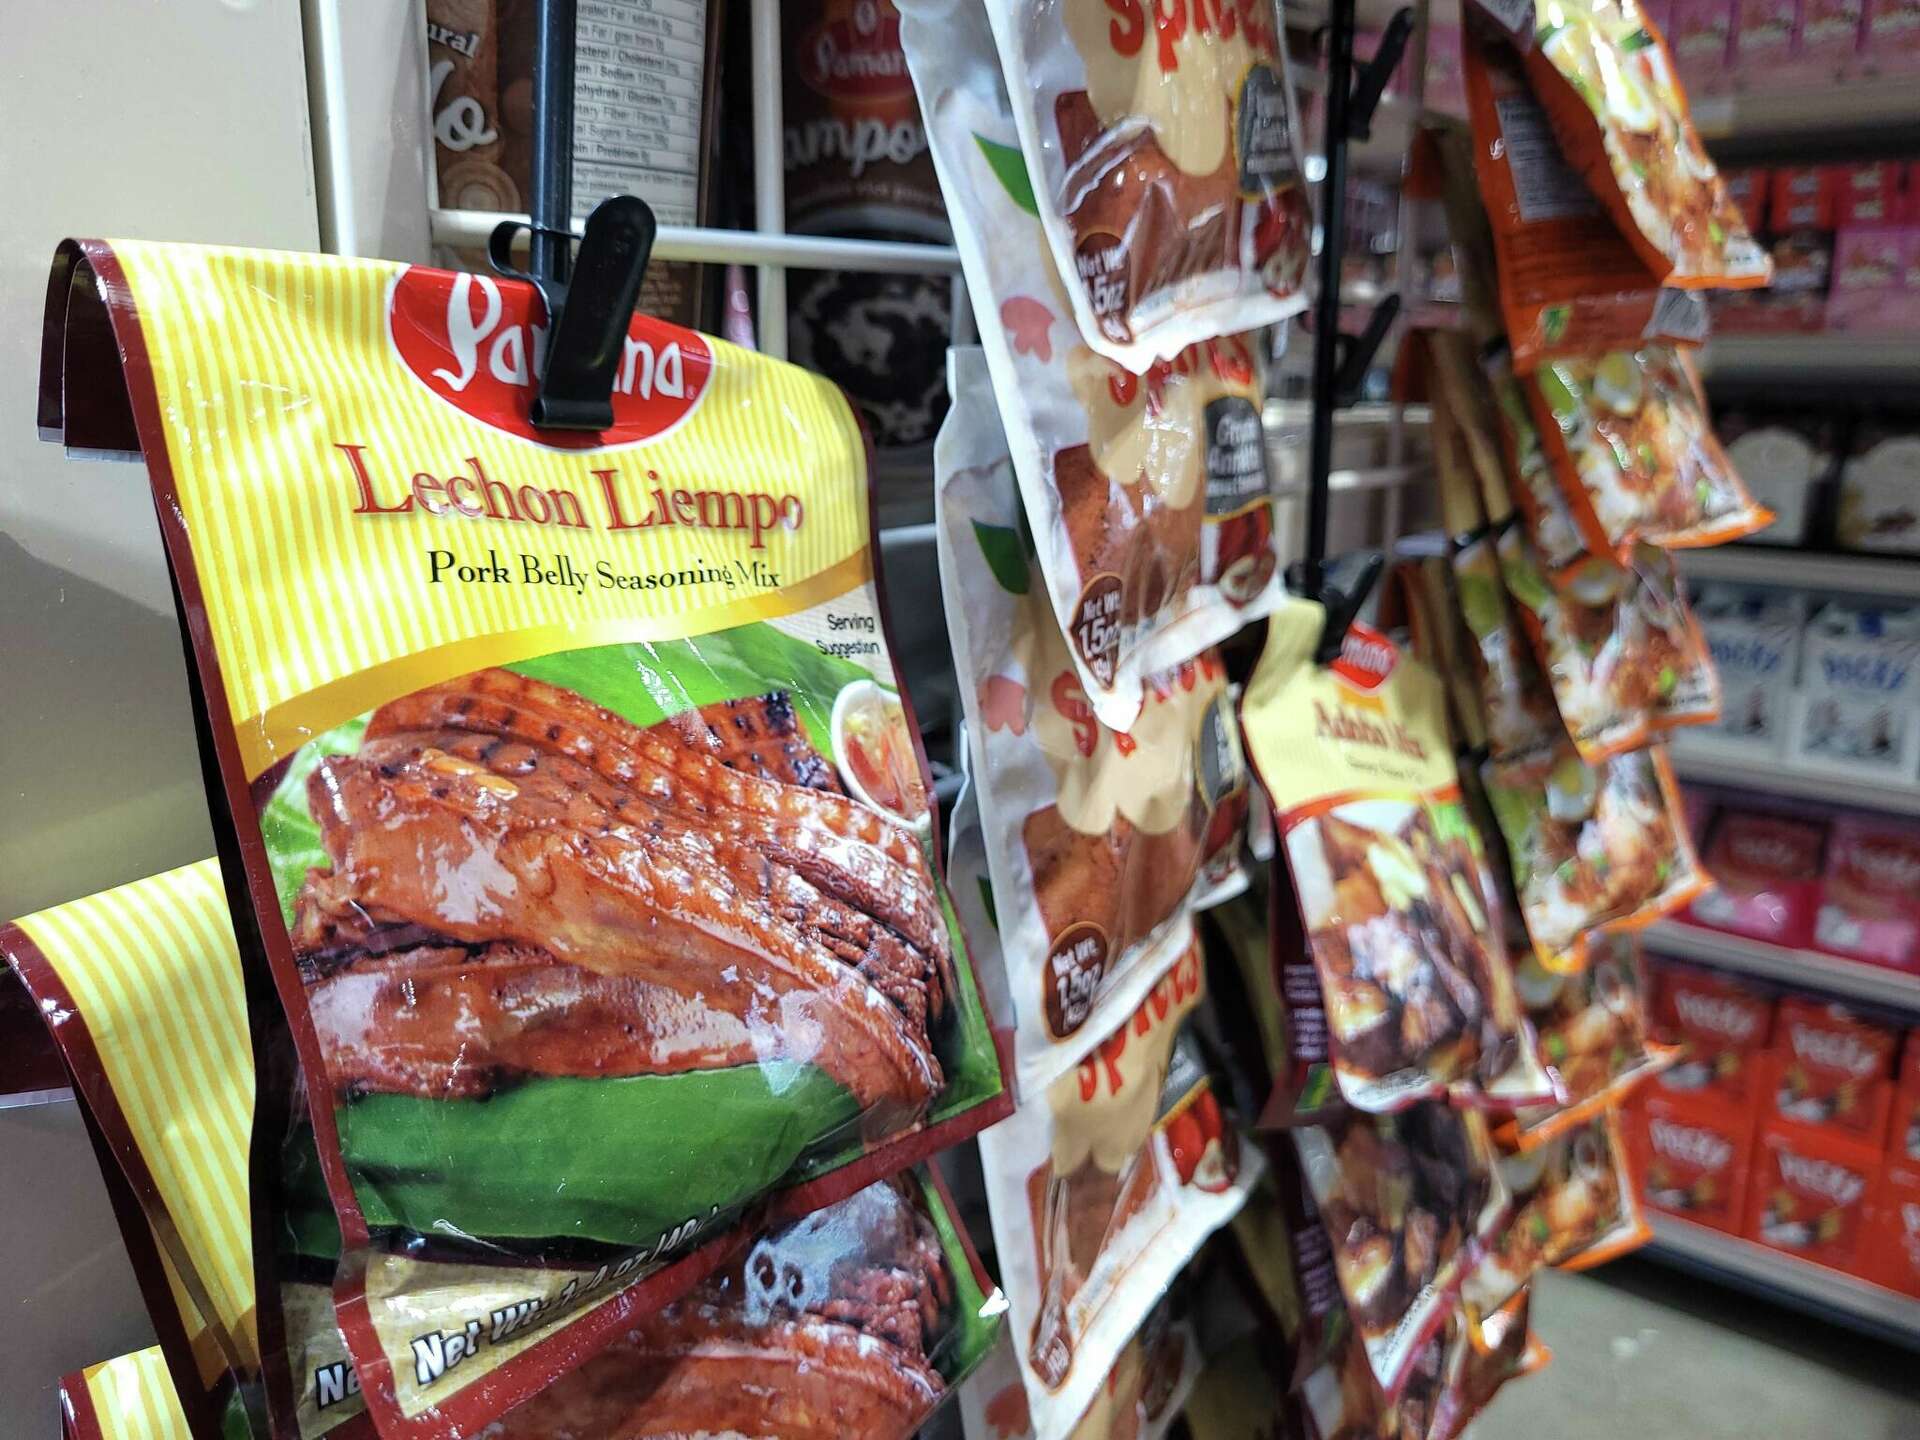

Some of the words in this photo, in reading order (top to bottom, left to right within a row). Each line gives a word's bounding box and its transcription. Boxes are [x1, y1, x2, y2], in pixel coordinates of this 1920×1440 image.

[432, 271, 684, 400] Pana
[334, 443, 592, 532] Lechon
[591, 467, 804, 550] Liempo
[428, 549, 512, 585] Pork
[519, 553, 590, 595] Belly
[597, 560, 735, 592] Seasoning
[735, 558, 781, 589] Mix
[827, 612, 875, 633] Serving
[815, 639, 880, 659] Suggestion
[410, 1319, 482, 1386] Net
[316, 1363, 363, 1410] Ne
